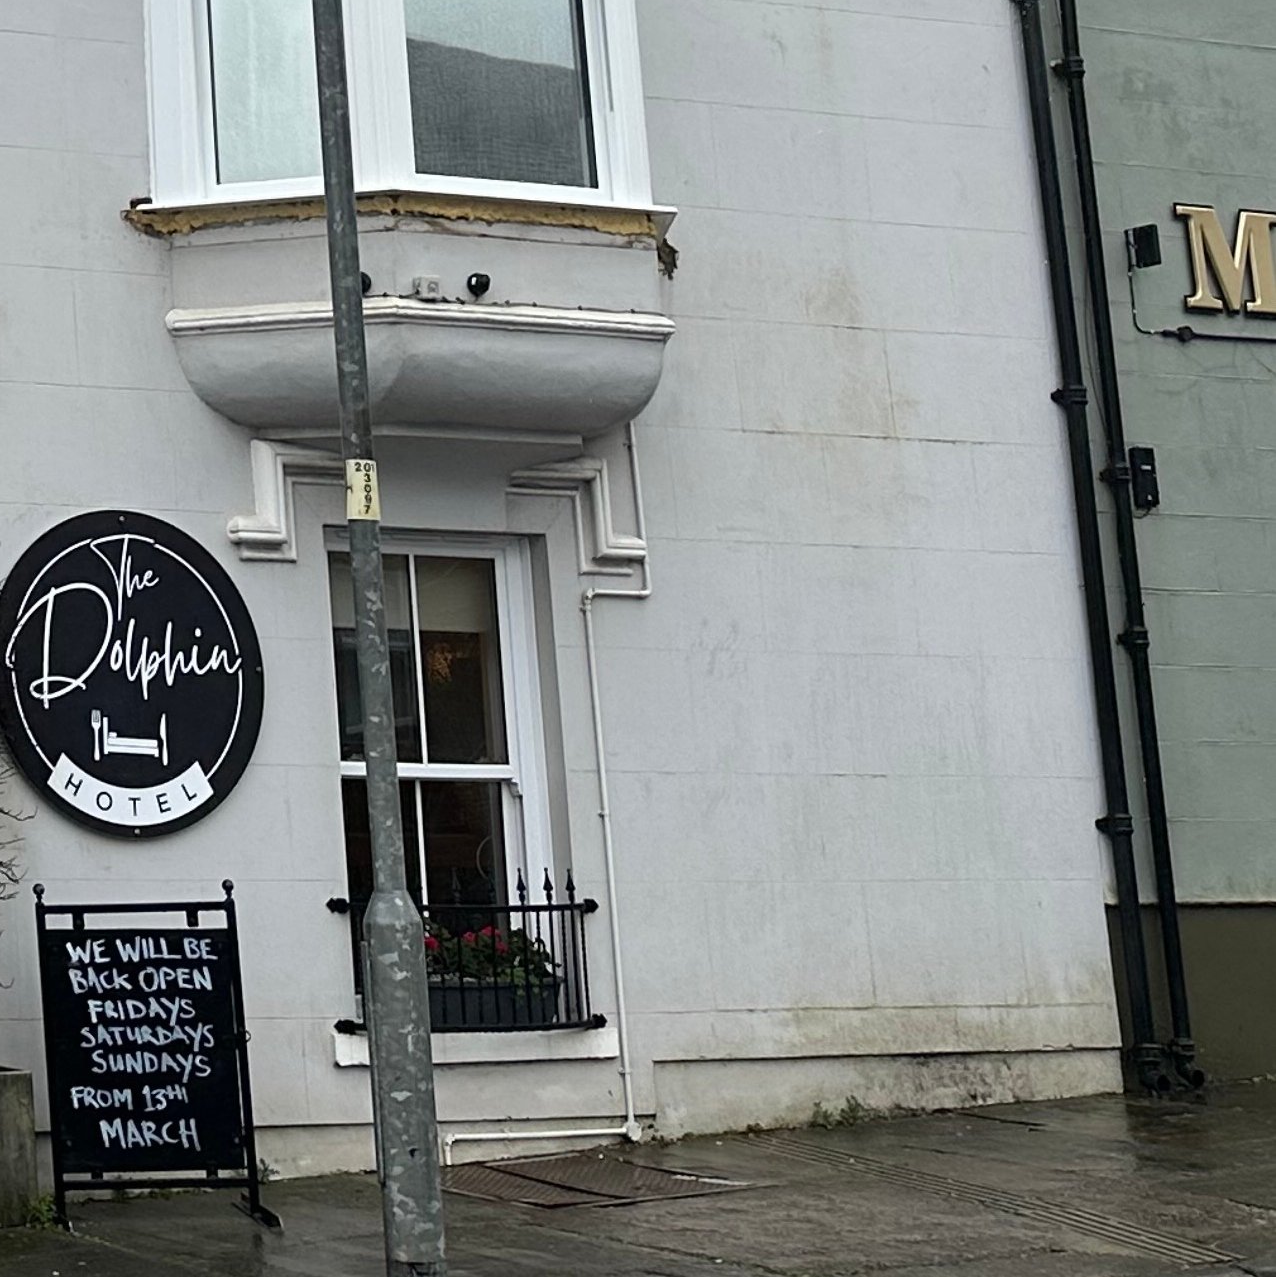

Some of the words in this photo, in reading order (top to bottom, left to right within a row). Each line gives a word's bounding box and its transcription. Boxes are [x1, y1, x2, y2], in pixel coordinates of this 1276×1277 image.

[90, 533, 160, 621] The
[5, 582, 242, 709] Dolphin
[64, 772, 198, 817] HOTEL
[66, 939, 111, 964] WE
[115, 935, 182, 962] WILL
[183, 937, 218, 960] BE
[68, 966, 133, 994] BACK
[138, 966, 213, 992] OPEN
[87, 996, 195, 1026] FRIDAYS
[80, 1022, 215, 1052] SATURDAYS
[91, 1049, 212, 1083] SUNDAYS
[70, 1086, 134, 1110] FROM
[99, 1117, 201, 1151] MARCH
